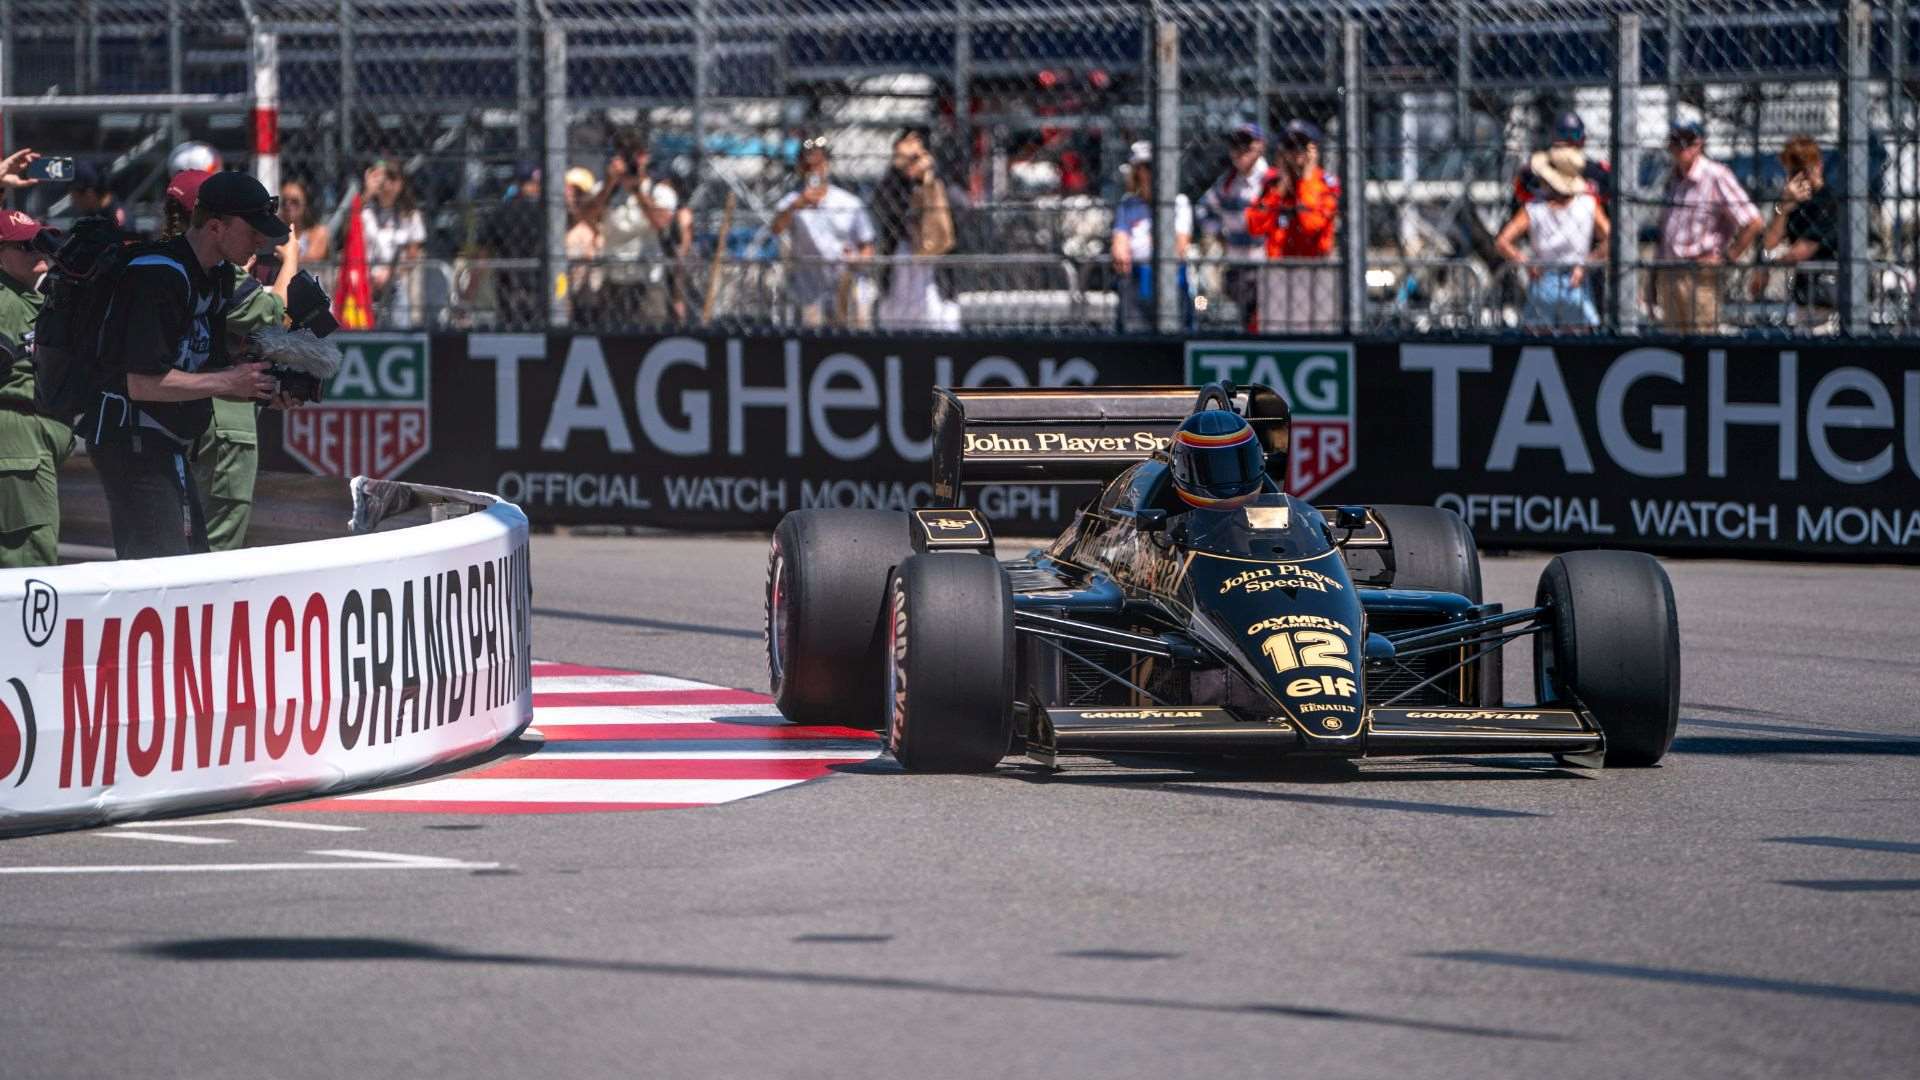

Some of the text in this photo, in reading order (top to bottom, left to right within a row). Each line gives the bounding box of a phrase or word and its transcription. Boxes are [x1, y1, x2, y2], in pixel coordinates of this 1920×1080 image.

[330, 346, 416, 398] AG
[963, 433, 1032, 452] John
[1034, 432, 1130, 453] Player
[497, 471, 1060, 522] OFFICIAL WATCH MONAC GPH
[1435, 492, 1614, 534] OFFICIAL
[1630, 498, 1778, 540] WATCH
[1220, 564, 1344, 595] John Player
[1244, 579, 1328, 594] Special
[1247, 615, 1353, 636] OLYMPUS
[1260, 630, 1355, 676] 12
[1286, 675, 1357, 697] elf
[1080, 710, 1203, 720] GOODYEAR
[1299, 703, 1356, 713] RENAULT
[1405, 711, 1540, 721] GOODYEAR
